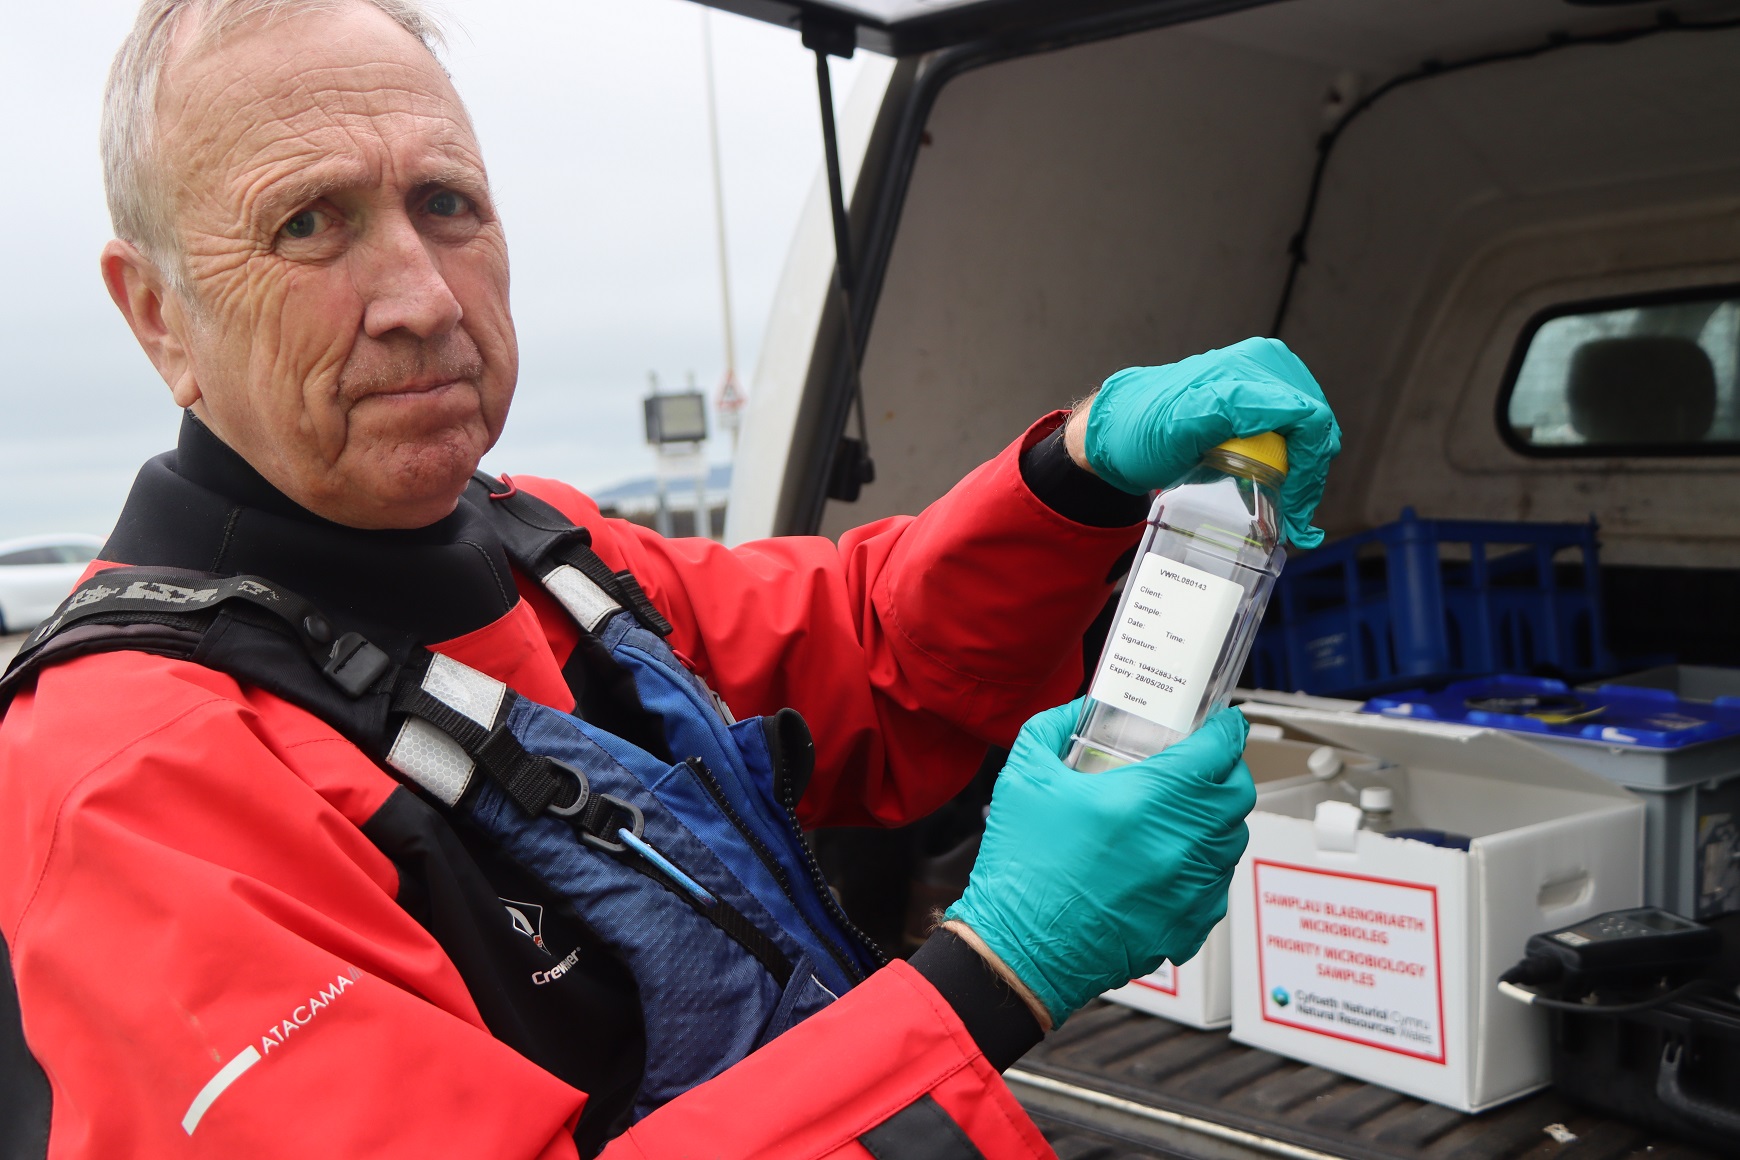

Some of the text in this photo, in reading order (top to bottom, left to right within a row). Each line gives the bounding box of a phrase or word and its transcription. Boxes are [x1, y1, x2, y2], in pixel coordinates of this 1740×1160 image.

[1160, 569, 1207, 591] VWRL080143
[1140, 586, 1163, 599] Client:
[1134, 602, 1162, 617] Sample:
[1121, 633, 1158, 652] Signature:
[1127, 617, 1186, 645] Date: Time:
[1114, 653, 1137, 666] Batch:
[1109, 664, 1174, 693] Expiry: 28/05/2025
[1123, 691, 1147, 706] Sterile
[1264, 892, 1426, 932] SAMPLAU BLAENORIAETH
[1266, 934, 1426, 978] PRIORITY MICROBIOLOGY
[1317, 963, 1376, 987] SAMPLES
[1296, 1004, 1334, 1021] Natural
[1337, 1013, 1395, 1035] Resources
